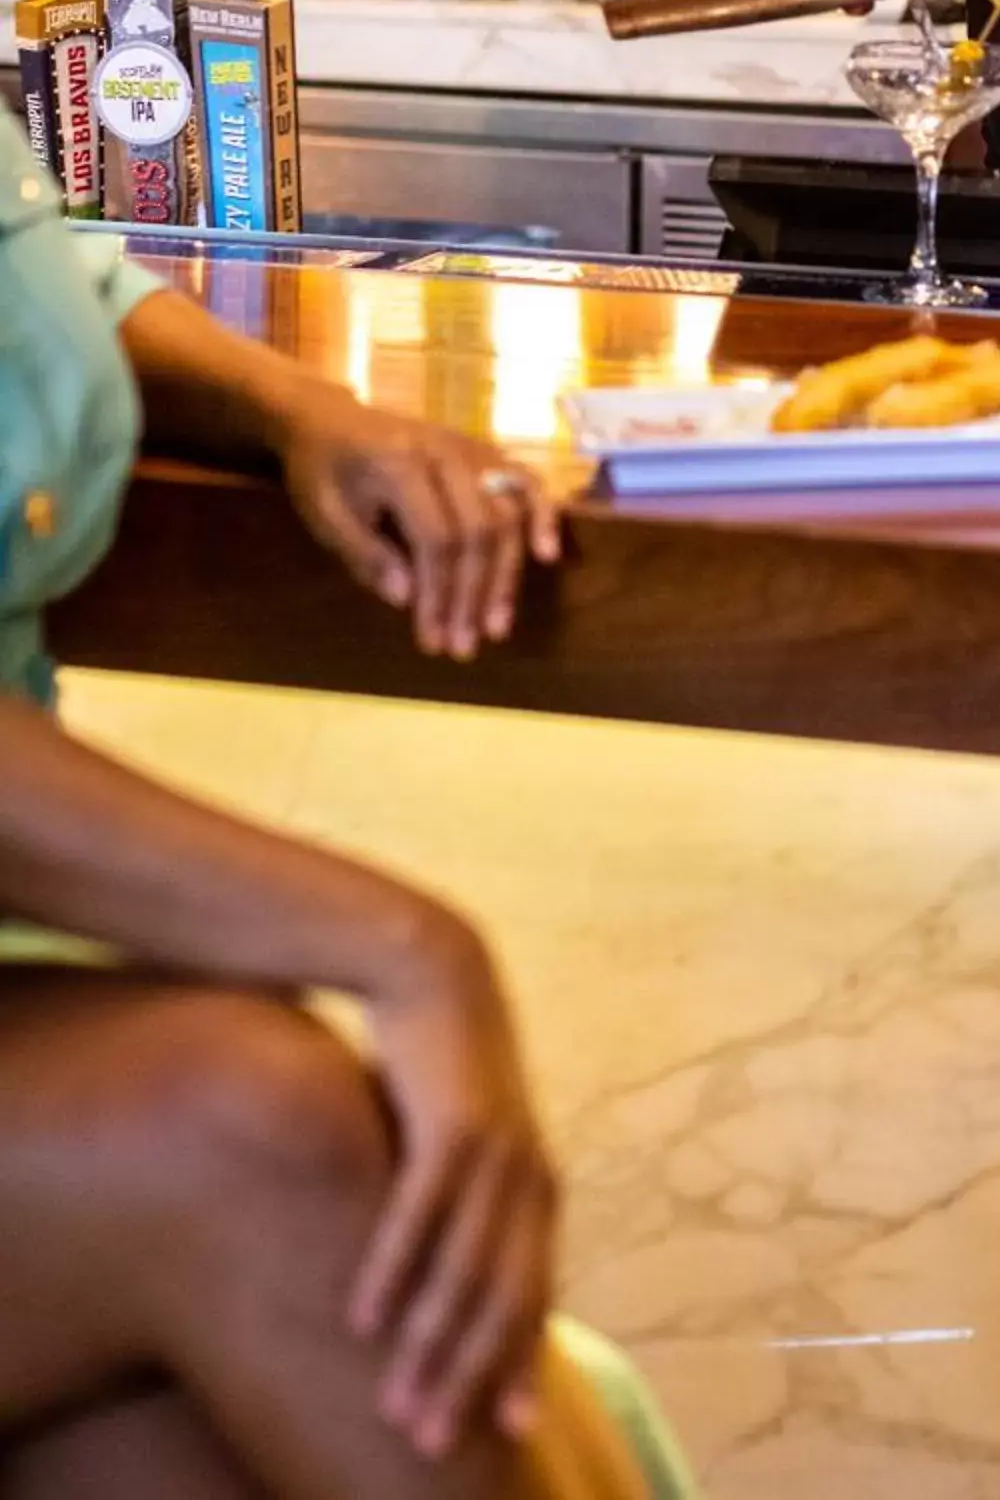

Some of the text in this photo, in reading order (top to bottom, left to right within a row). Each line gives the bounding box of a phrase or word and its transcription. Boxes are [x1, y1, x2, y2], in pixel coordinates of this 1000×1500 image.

[103, 80, 181, 101] BASEMENT
[130, 100, 156, 122] IPA
[68, 45, 93, 193] LOS BRAVOS
[219, 110, 247, 147] ALE
[221, 150, 250, 201] PALE
[279, 159, 295, 231] RE
